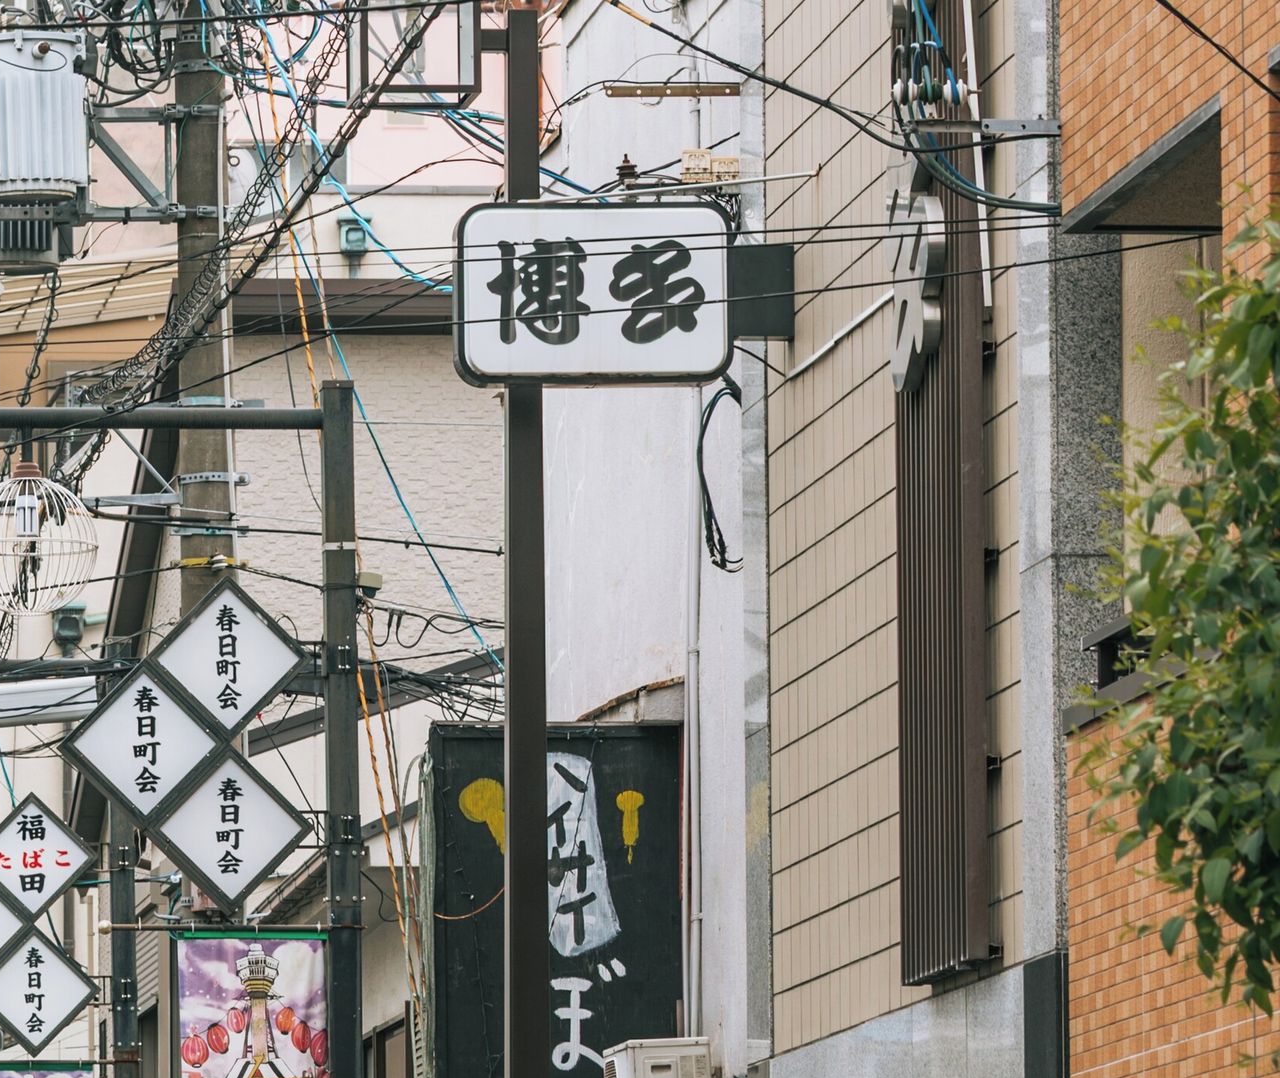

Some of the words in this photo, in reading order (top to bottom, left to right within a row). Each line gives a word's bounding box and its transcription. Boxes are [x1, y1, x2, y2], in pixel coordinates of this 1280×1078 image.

[215, 604, 241, 711] 春日町会
[132, 686, 161, 794] 春日町会
[216, 777, 244, 875] 春日町会
[23, 946, 45, 1034] 春日町会
